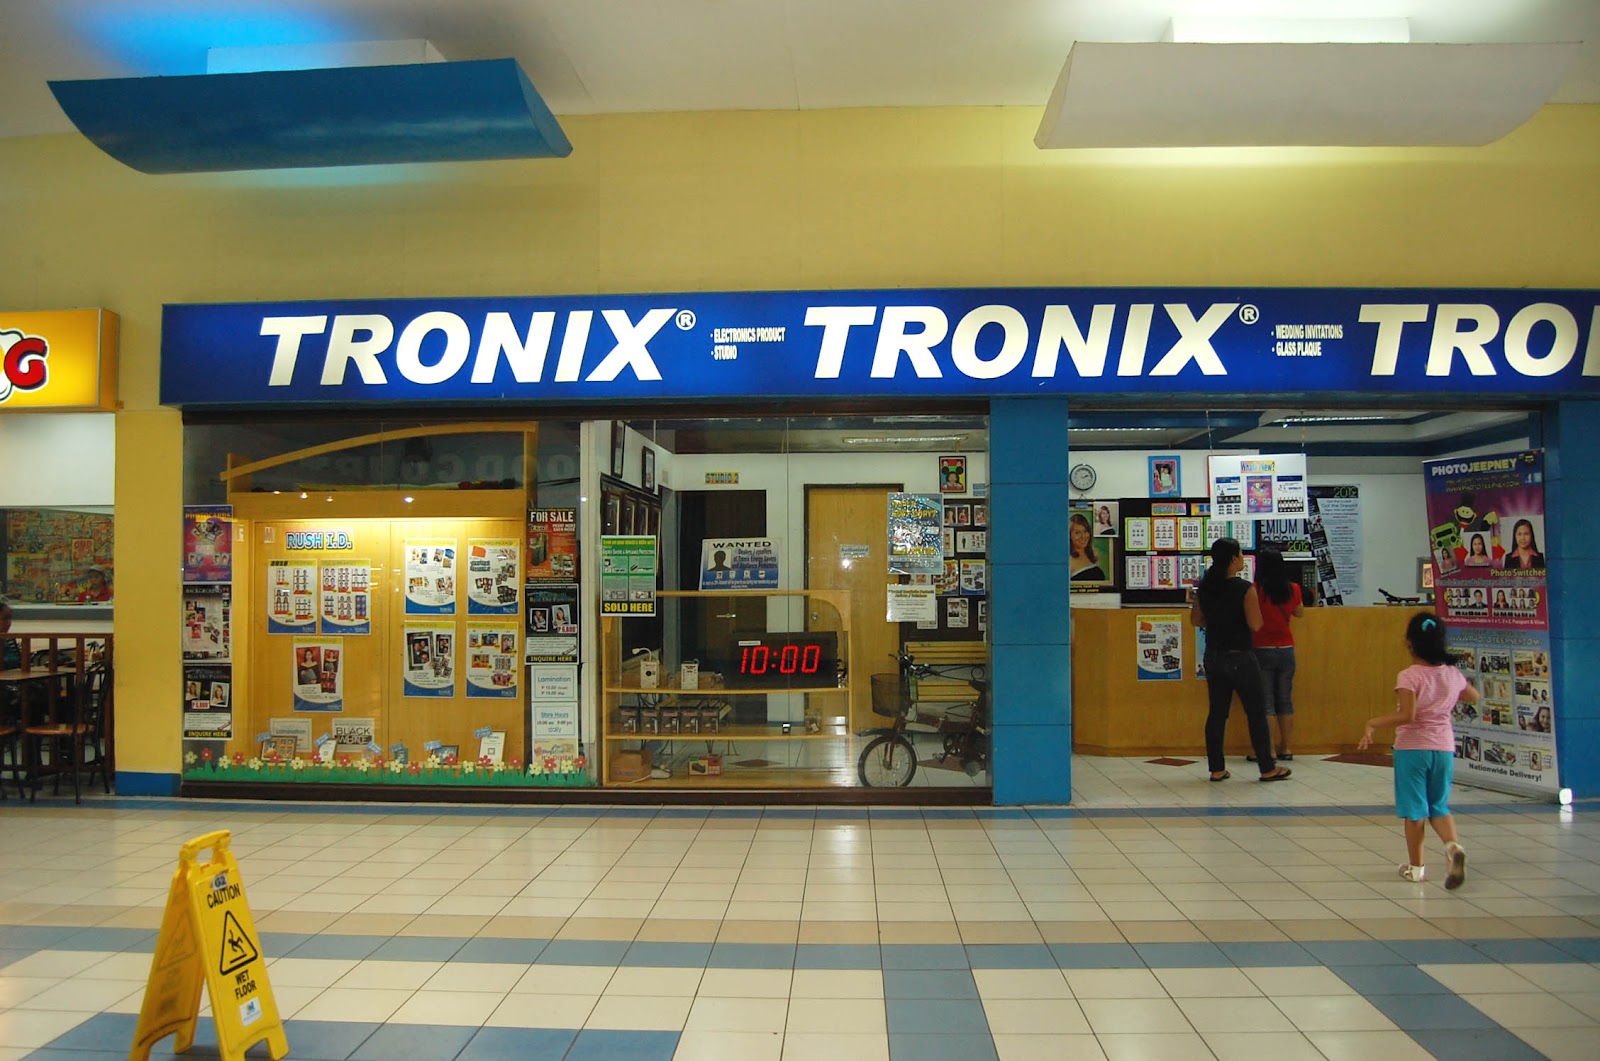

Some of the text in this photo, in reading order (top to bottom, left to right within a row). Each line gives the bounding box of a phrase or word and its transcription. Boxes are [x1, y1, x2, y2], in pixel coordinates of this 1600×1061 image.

[713, 327, 786, 343] ELECTRONICS PRODUCT
[1275, 324, 1344, 339] WEDDING INVITATIONS
[713, 345, 738, 360] STUDIO
[1276, 341, 1322, 357] GLASS PLAQUE
[1431, 458, 1517, 477] PHOTOJEEPNEY
[530, 511, 574, 523] FOR SALE
[286, 532, 353, 550] RUSH I.D.
[712, 541, 772, 549] WANTED
[1490, 568, 1546, 577] Photo Switched
[604, 603, 653, 612] SOLD HERE
[741, 645, 821, 674] 10:00
[336, 727, 370, 735] BLACK
[1469, 763, 1542, 782] Nationwide Delivery!
[207, 883, 241, 909] CAUTION
[235, 970, 249, 985] WET
[235, 980, 256, 1000] FLOOR
